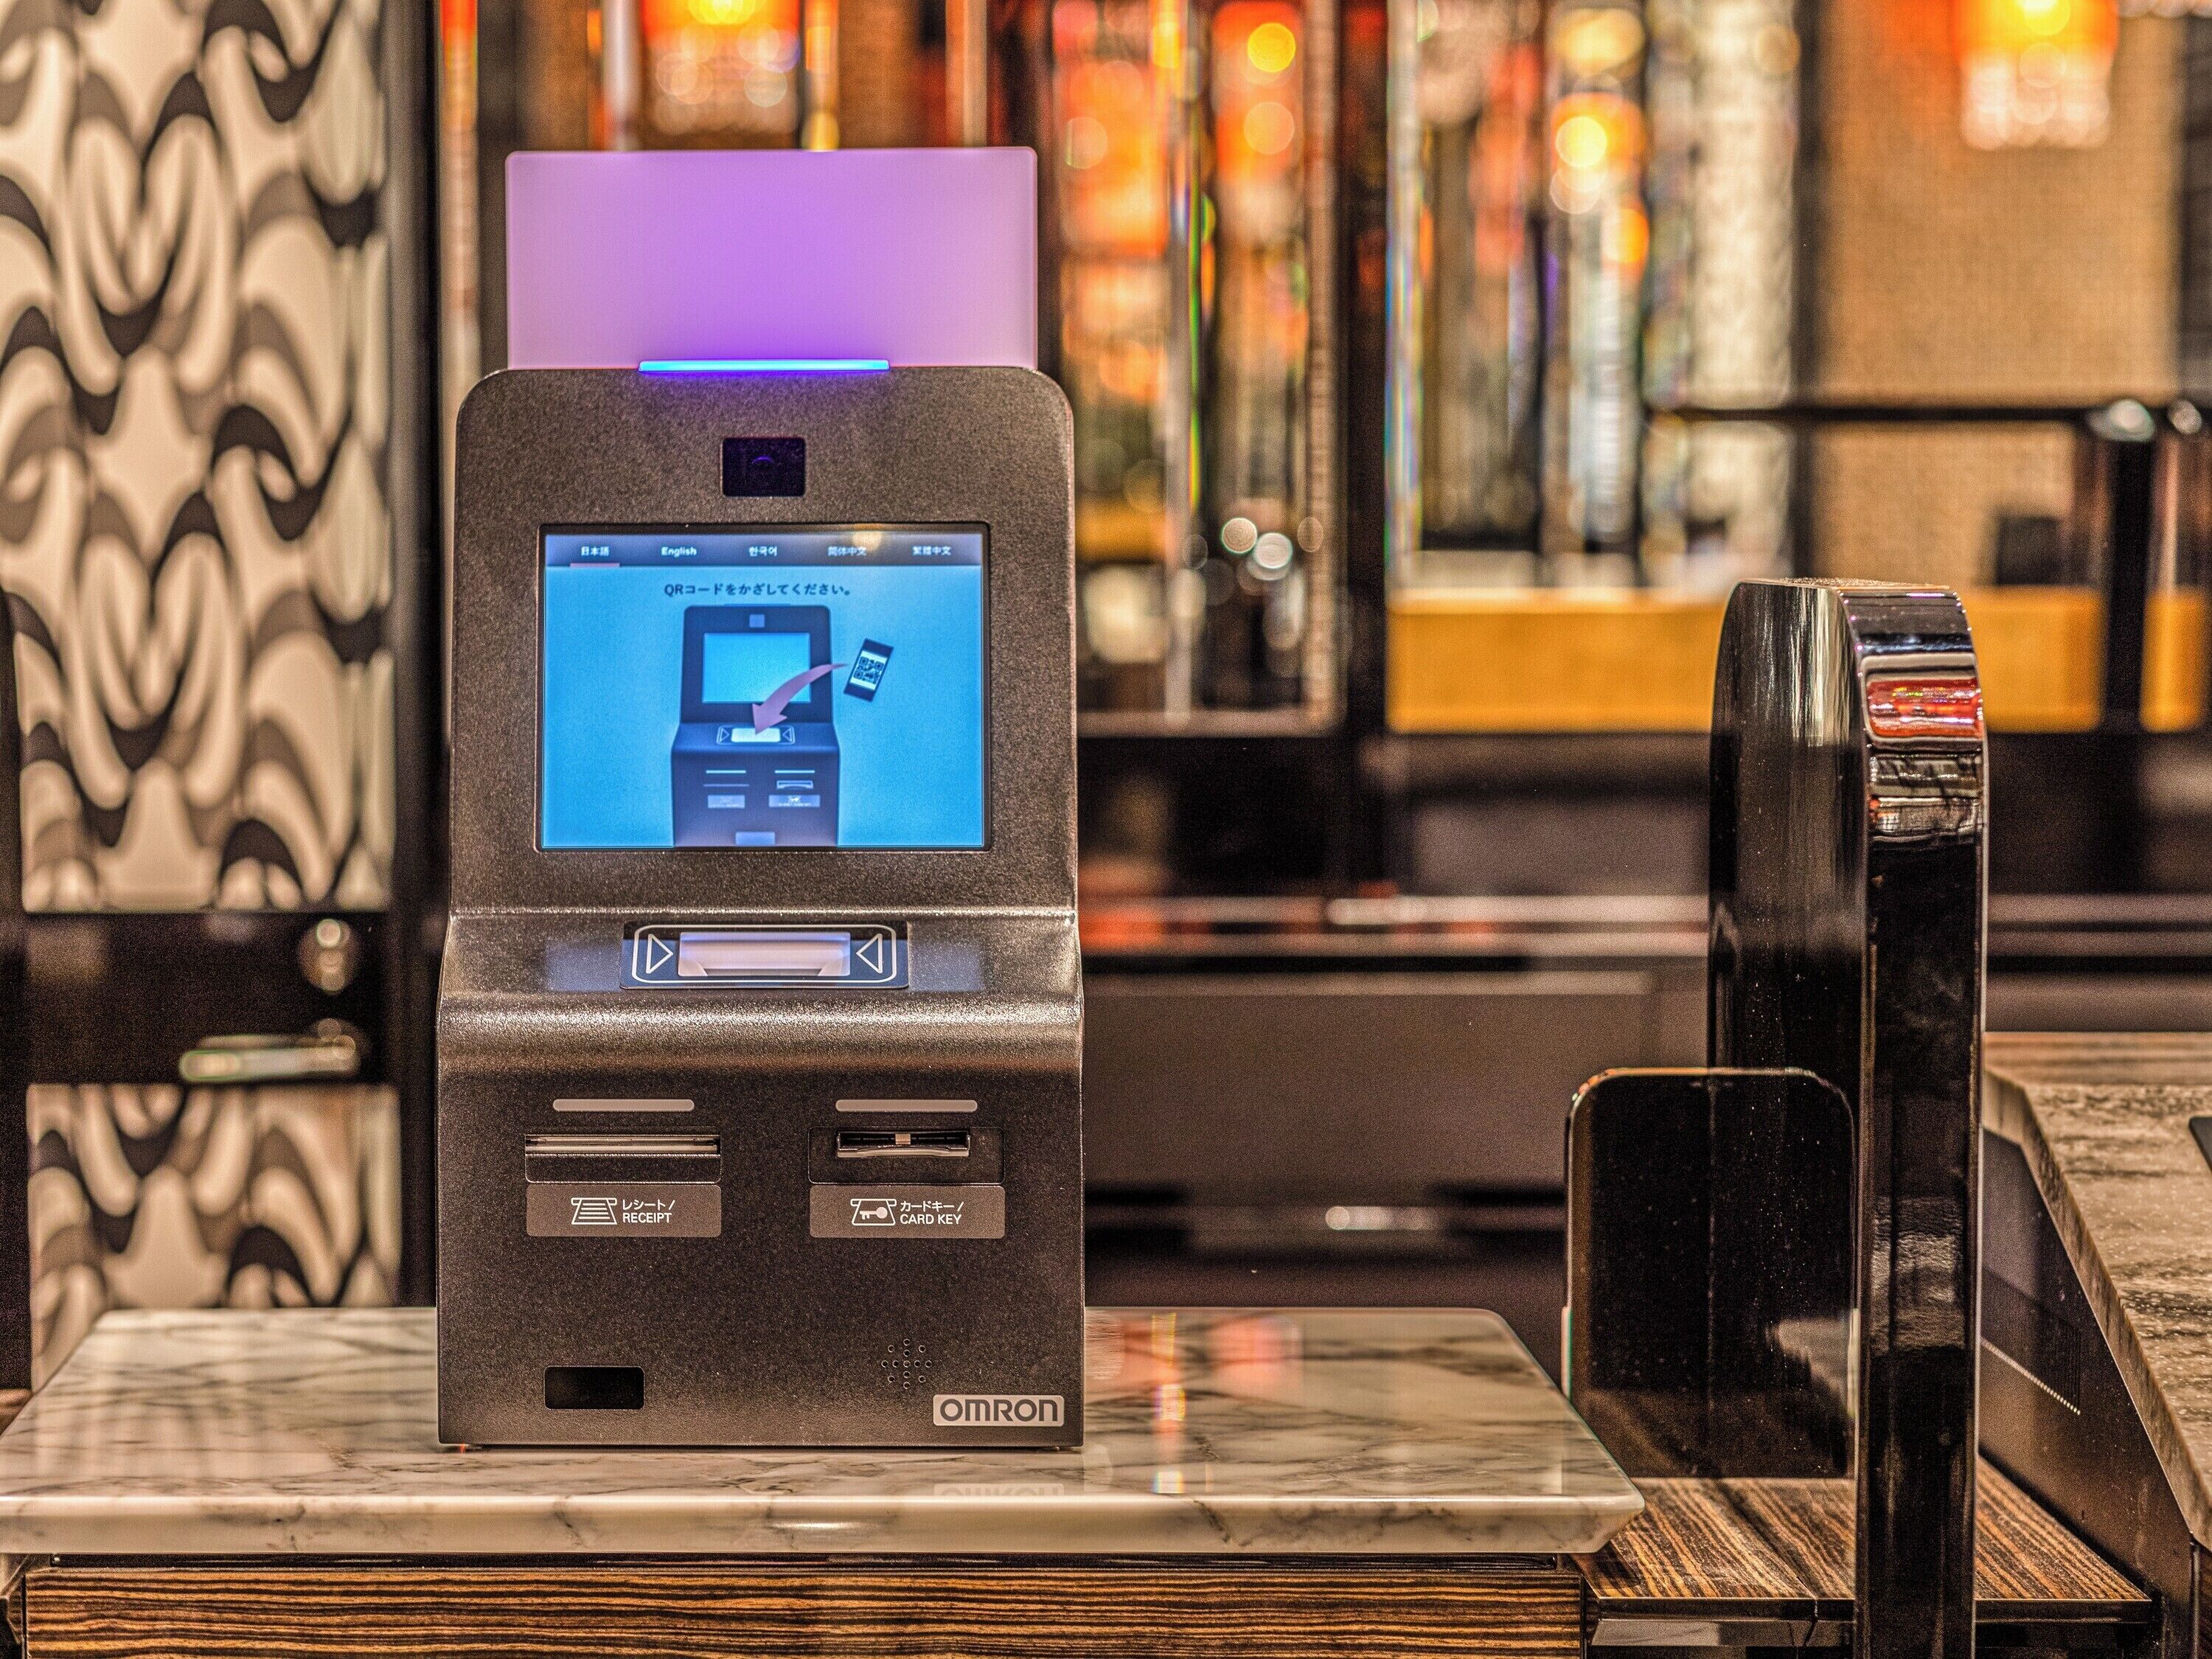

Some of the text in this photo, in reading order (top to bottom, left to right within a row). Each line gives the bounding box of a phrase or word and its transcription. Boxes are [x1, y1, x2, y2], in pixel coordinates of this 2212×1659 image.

[581, 546, 610, 557] 日本語
[661, 546, 697, 558] English
[748, 546, 778, 557] 한국어
[664, 582, 850, 598] QRコードをかざしてください。
[622, 1212, 672, 1223] RECEIPT
[900, 1214, 962, 1225] CARD KEY
[940, 1398, 1058, 1422] OMRON
